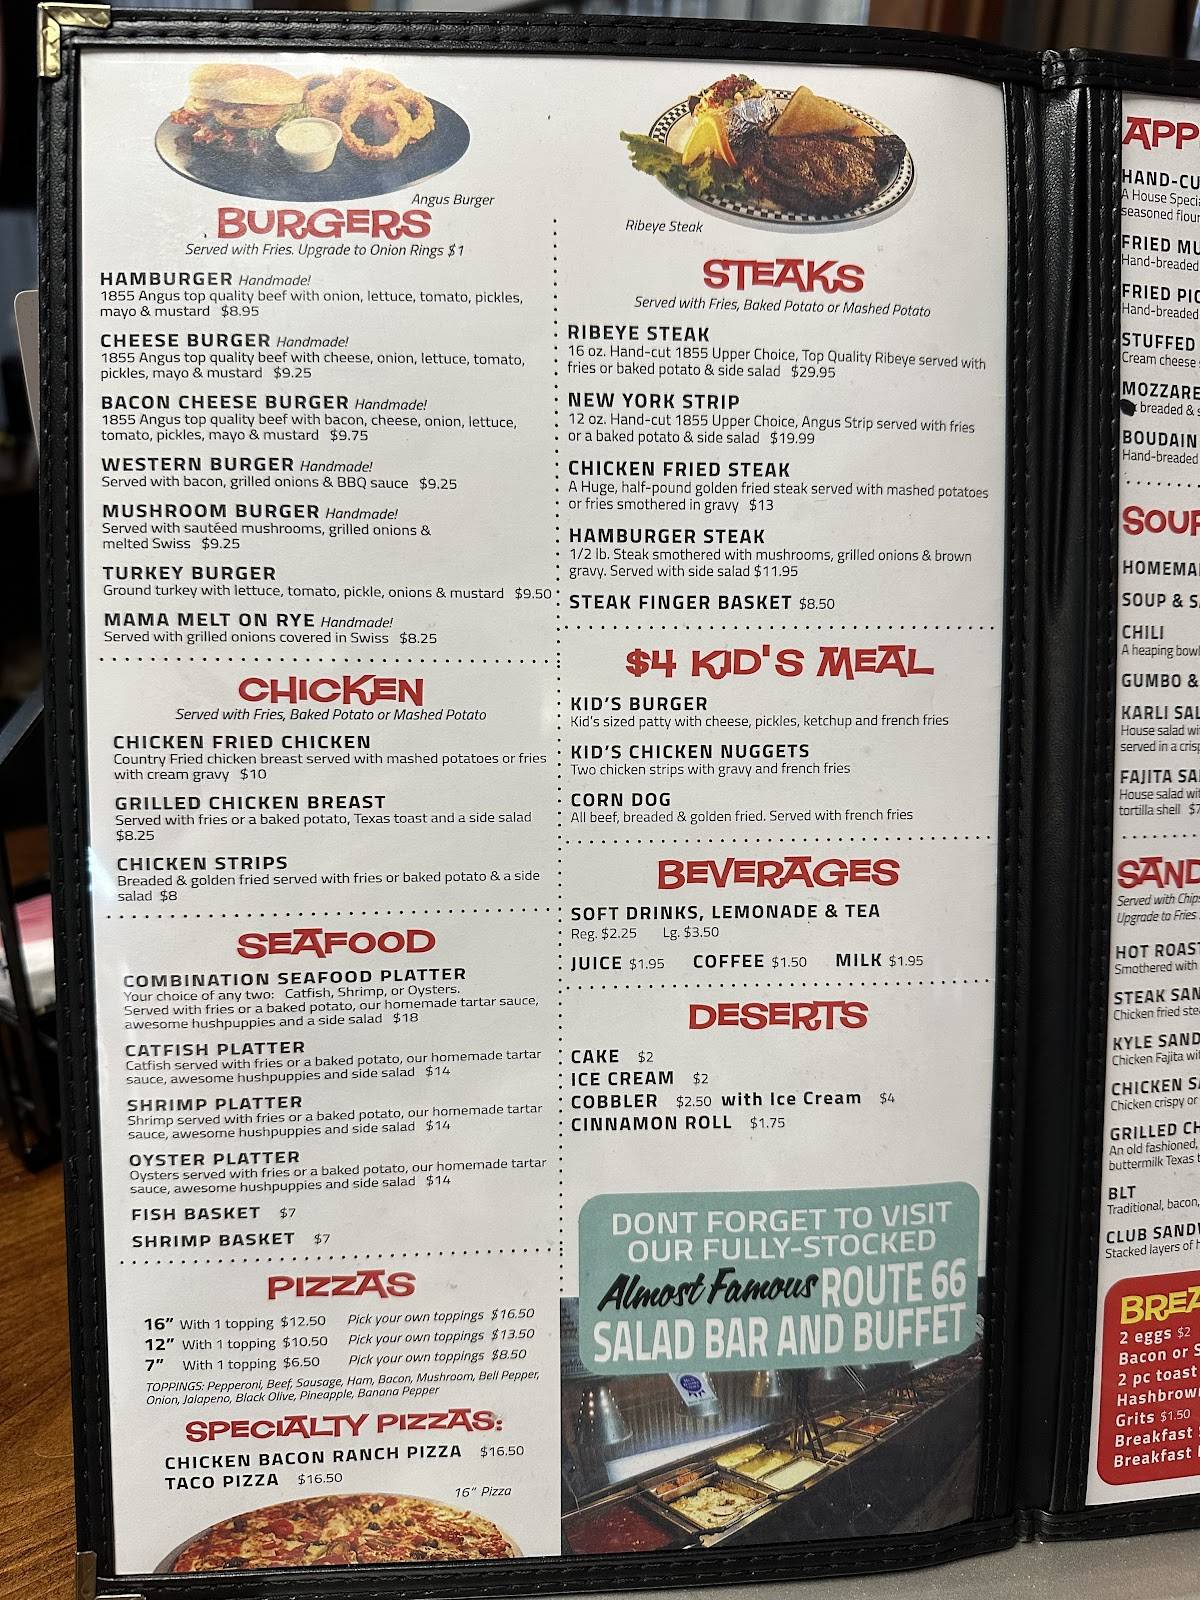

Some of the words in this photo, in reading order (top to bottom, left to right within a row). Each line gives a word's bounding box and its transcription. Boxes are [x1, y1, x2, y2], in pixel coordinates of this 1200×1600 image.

[412, 193, 450, 208] Angus
[454, 193, 495, 208] Burger
[217, 208, 431, 240] BURGERS
[625, 219, 665, 234] Ribeye
[669, 220, 703, 233] Steak
[1121, 255, 1199, 272] Hand-breaded
[100, 271, 233, 286] HAMBURGER
[239, 274, 312, 286] Handmade!
[703, 258, 865, 294] STEAKS
[101, 291, 135, 302] 1855
[139, 291, 180, 304] Angus
[184, 291, 205, 304] top
[210, 290, 254, 304] quality
[259, 290, 287, 302] beef
[291, 290, 319, 302] with
[324, 291, 363, 304] onion,
[368, 291, 416, 304] lettuce,
[420, 292, 471, 304] tomato,
[476, 292, 523, 305] pickles,
[100, 308, 136, 319] mayo
[140, 306, 151, 317] &
[155, 305, 210, 317] mustard
[221, 305, 259, 318] $8.95
[568, 325, 639, 340] RIBEYE
[648, 326, 709, 342] STEAK
[1122, 332, 1195, 351] STUFFED
[568, 361, 595, 375] fries
[600, 364, 613, 375] or
[617, 362, 654, 375] baked
[659, 363, 701, 378] potato
[705, 364, 715, 376] &
[718, 364, 743, 377] side
[748, 364, 780, 377] salad
[791, 365, 836, 379] $29.95
[101, 395, 170, 410] BACON
[179, 395, 257, 410] CHEESE
[266, 395, 348, 410] BURGER
[355, 399, 428, 411] Handmade!
[568, 393, 615, 408] NEW
[623, 393, 675, 409] YORK
[683, 394, 740, 410] STRIP
[1122, 430, 1197, 449] BOUDAIN
[102, 475, 146, 487] Served
[150, 476, 179, 487] with
[184, 476, 226, 489] bacon,
[231, 476, 271, 489] grilled
[275, 476, 318, 487] onions
[323, 476, 334, 488] &
[338, 477, 367, 490] BBQ
[371, 479, 409, 490] sauce
[419, 477, 457, 490] $9.25
[103, 567, 183, 581] TURKEY
[192, 566, 275, 581] BURGER
[569, 594, 631, 610] STEAK
[640, 594, 709, 610] FINGER
[719, 594, 792, 610] BASKET
[800, 597, 835, 611] $8.50
[105, 612, 169, 627] MAMA
[178, 612, 230, 627] MELT
[239, 613, 267, 627] ON
[277, 613, 315, 628] RYE
[321, 616, 394, 629] Handmade!
[1122, 625, 1164, 640] CHILI
[1121, 644, 1129, 655] A
[1132, 644, 1174, 659] heaping
[625, 649, 677, 679] $4
[816, 645, 935, 680] MEAL
[238, 674, 425, 706] CHICKEN
[630, 744, 712, 759] CHICKEN
[721, 743, 809, 758] NUGGETS
[571, 764, 596, 776] Two
[600, 763, 646, 776] chicken
[650, 763, 684, 778] strips
[688, 763, 714, 775] with
[719, 766, 752, 778] gravy
[756, 763, 778, 775] and
[782, 763, 819, 775] french
[824, 763, 851, 774] fries
[115, 796, 201, 811] GRILLED
[210, 796, 299, 810] CHICKEN
[308, 795, 386, 809] BREAST
[658, 856, 900, 890] BEVERAGES
[237, 928, 436, 960] SEAFOOD
[571, 955, 622, 972] JUICE
[629, 957, 665, 971] $1.95
[694, 954, 764, 969] COFFEE
[772, 956, 807, 970] $1.50
[836, 953, 882, 967] MILK
[889, 955, 924, 968] $1.95
[1114, 962, 1172, 975] Smothered
[1175, 960, 1198, 972] with
[123, 972, 269, 988] COMBINATION
[278, 970, 373, 985] SEAFOOD
[381, 967, 467, 982] PLATTER
[688, 1001, 869, 1031] DESERTS
[571, 1049, 619, 1064] CAKE
[638, 1050, 654, 1064] $2
[127, 1076, 167, 1086] sauce,
[171, 1075, 234, 1085] awesome
[238, 1070, 321, 1084] hushpuppies
[325, 1069, 348, 1080] and
[352, 1067, 378, 1079] side
[382, 1066, 415, 1078] salad
[425, 1065, 451, 1078] $14
[571, 1093, 658, 1109] COBBLER
[676, 1094, 712, 1108] $2.50
[722, 1092, 762, 1107] with
[770, 1092, 796, 1106] Ice
[804, 1090, 861, 1106] Cream
[879, 1092, 895, 1105] $4
[1110, 1099, 1152, 1112] Chicken
[1155, 1096, 1185, 1111] crispy
[1188, 1096, 1198, 1106] or
[1108, 1185, 1137, 1200] BLT
[131, 1208, 176, 1221] FISH
[185, 1206, 261, 1220] BASKET
[279, 1206, 296, 1219] $7
[612, 1211, 698, 1236] DONT
[707, 1209, 827, 1233] FORGET
[834, 1206, 873, 1229] TO
[881, 1201, 953, 1227] VISIT
[628, 1238, 693, 1263] OUR
[703, 1229, 937, 1261] FULLY-STOCKED
[268, 1269, 417, 1299] PIZZAS
[597, 1271, 706, 1312] Almost
[707, 1267, 819, 1304] Famous
[822, 1262, 922, 1308] ROUTE
[931, 1257, 967, 1300] 66
[180, 1318, 210, 1330] With
[215, 1319, 221, 1329] 1
[224, 1317, 274, 1331] topping
[280, 1315, 326, 1328] $12.50
[348, 1313, 373, 1325] Pick
[376, 1315, 402, 1327] your
[406, 1315, 430, 1323] own
[434, 1310, 484, 1324] toppings
[491, 1307, 535, 1321] $16.50
[593, 1319, 695, 1363] SALAD
[705, 1315, 768, 1359] BAR
[777, 1310, 844, 1356] AND
[854, 1302, 966, 1349] BUFFET
[1119, 1331, 1129, 1345] 2
[1134, 1328, 1172, 1346] eggs
[1177, 1326, 1191, 1339] $2
[185, 1413, 369, 1442] SPECIALTY
[377, 1407, 503, 1433] PIZZAS:
[1115, 1411, 1155, 1428] Grits
[1160, 1408, 1191, 1423] $1.50
[165, 1475, 215, 1490] TACO
[223, 1473, 279, 1488] PIZZA
[298, 1472, 343, 1486] $16.50
[481, 1485, 512, 1498] Pizza
